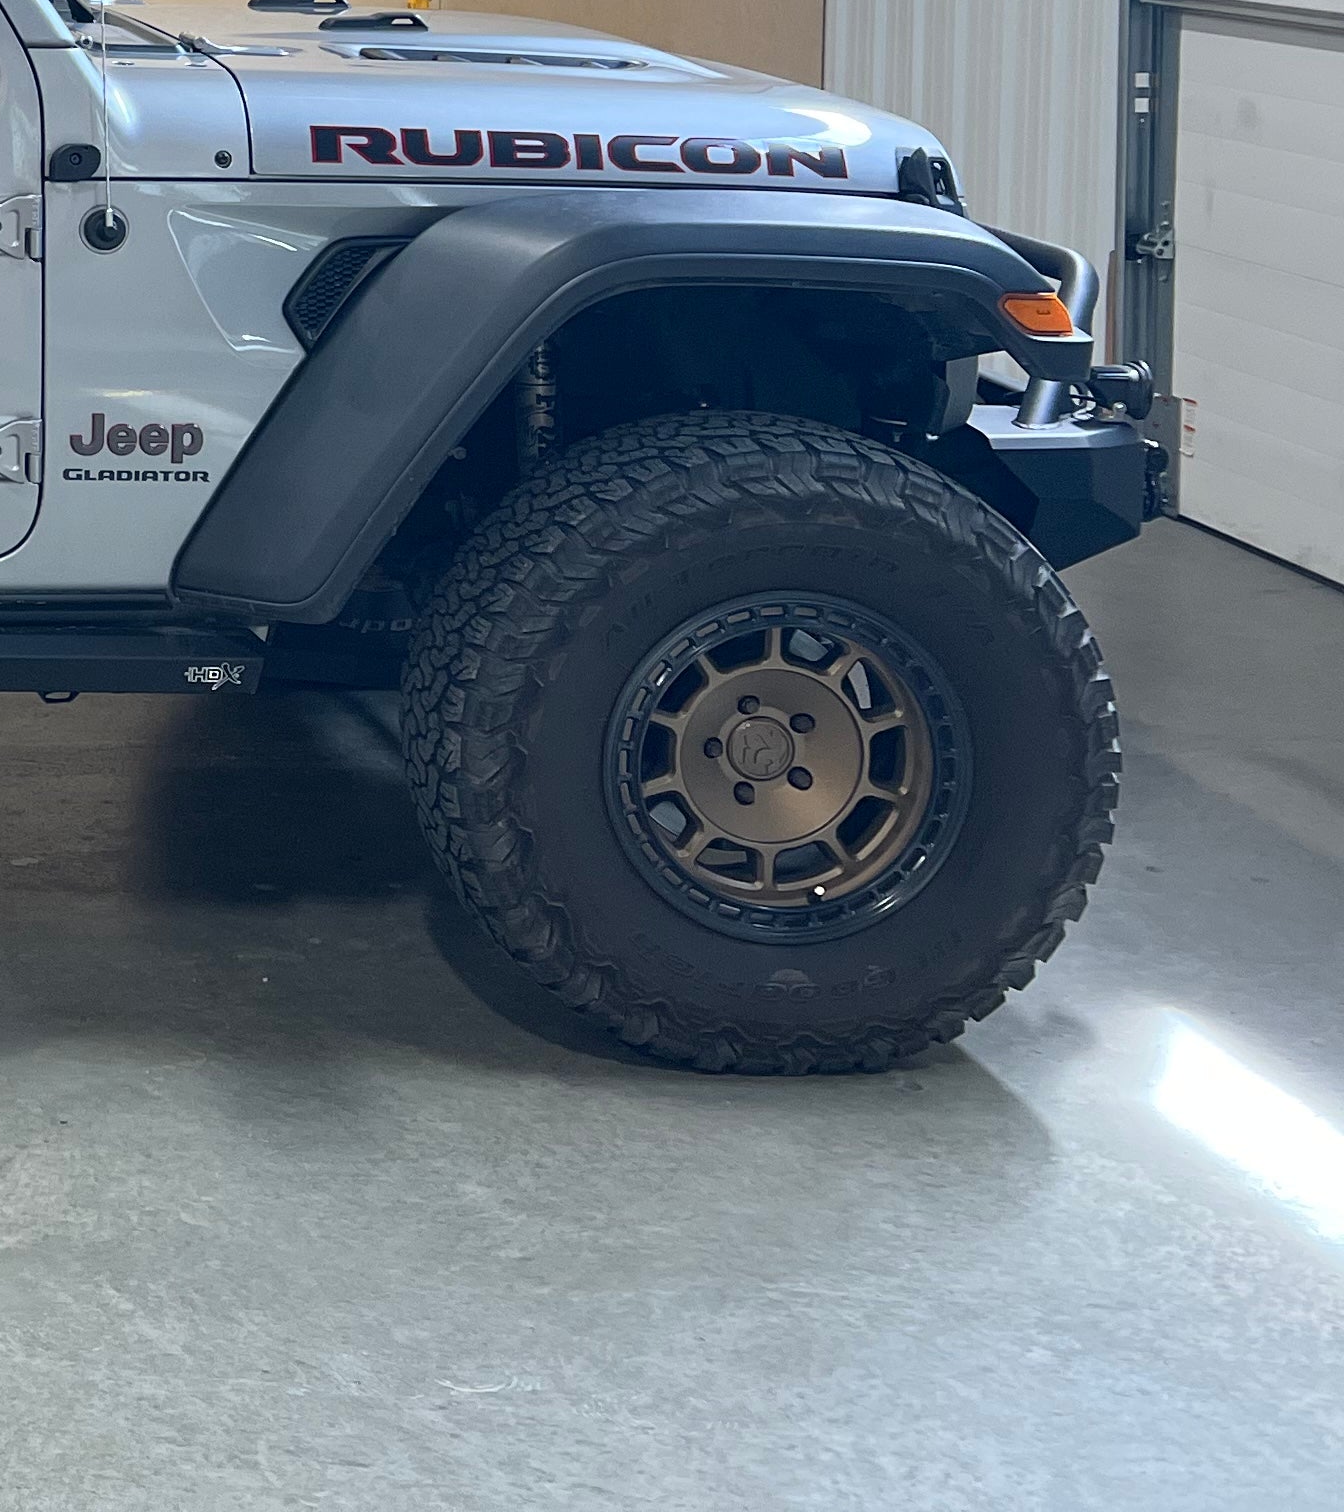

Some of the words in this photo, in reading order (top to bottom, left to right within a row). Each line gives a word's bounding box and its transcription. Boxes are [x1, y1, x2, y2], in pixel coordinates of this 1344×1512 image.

[309, 124, 850, 180] RUBICON
[69, 412, 204, 464] Jeep
[62, 468, 211, 483] GLADIATOR
[187, 662, 246, 691] HDX
